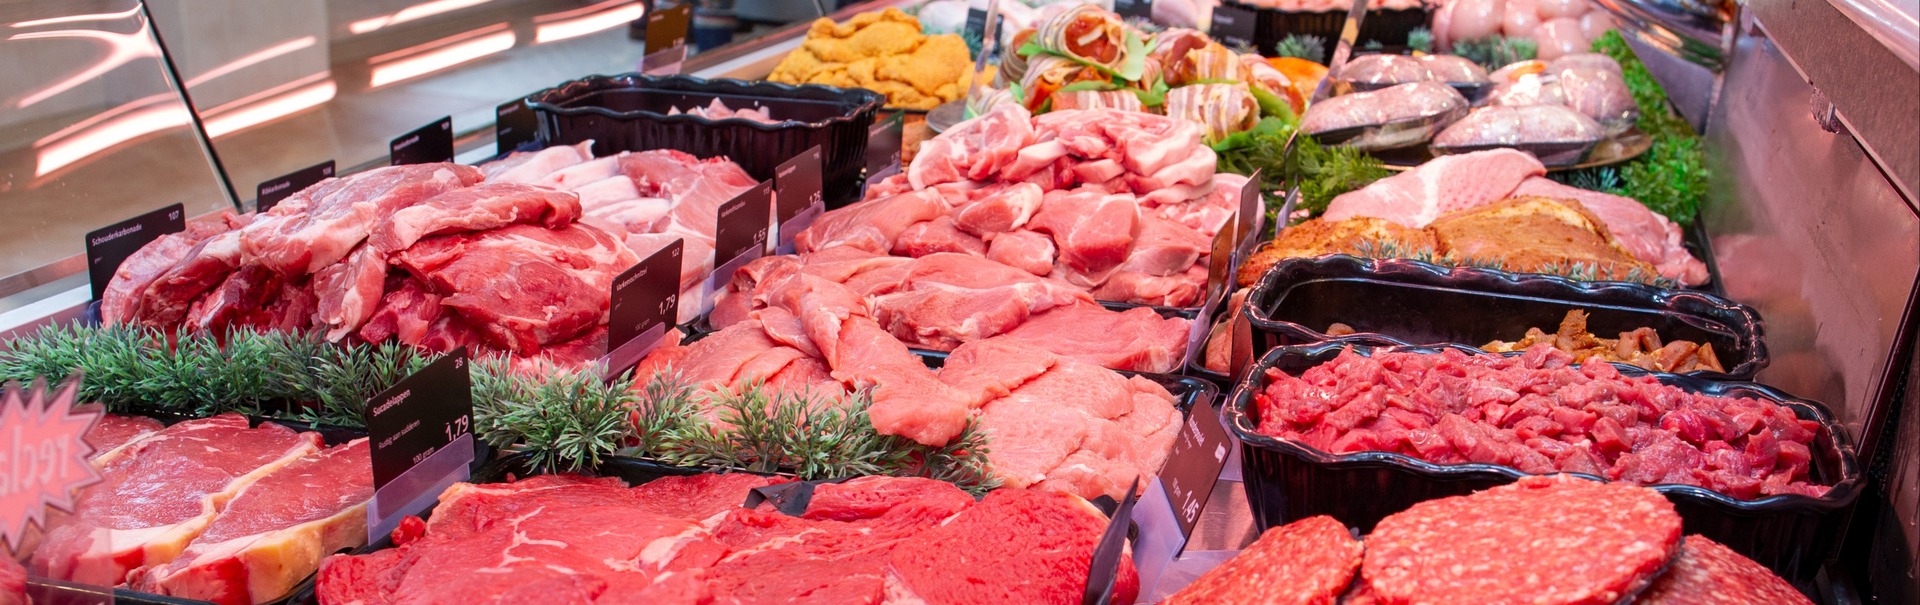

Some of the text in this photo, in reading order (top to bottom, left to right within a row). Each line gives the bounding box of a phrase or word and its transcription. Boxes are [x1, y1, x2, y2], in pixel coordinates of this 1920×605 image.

[168, 210, 179, 221] 107
[92, 223, 142, 247] Schouderkarbonade
[671, 247, 680, 258] 122
[659, 294, 675, 315] 1,79
[454, 357, 463, 369] 28
[373, 389, 411, 417] Sucadelappen
[445, 414, 469, 441] 1,79
[413, 453, 422, 464] 100
[1182, 490, 1199, 523] 1,45
